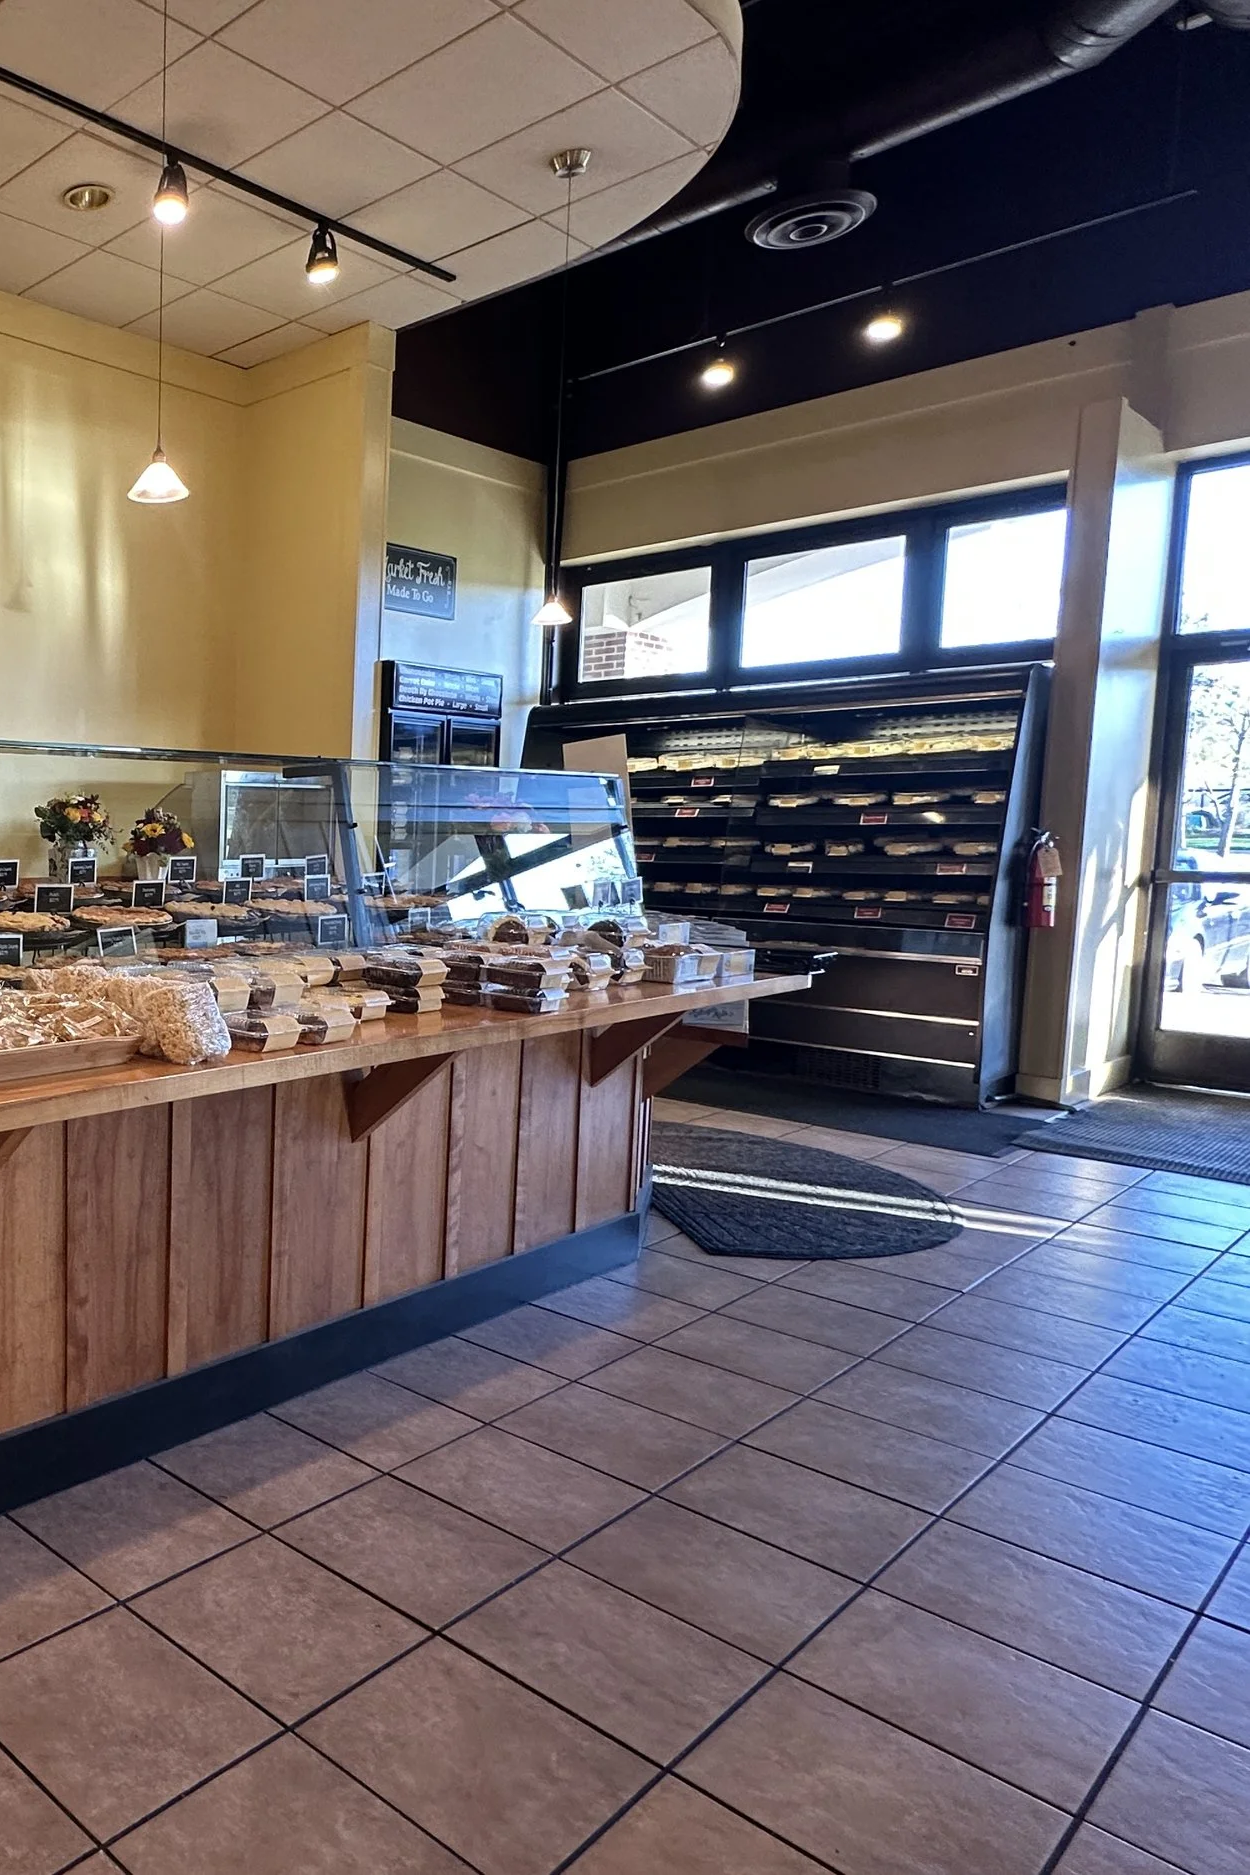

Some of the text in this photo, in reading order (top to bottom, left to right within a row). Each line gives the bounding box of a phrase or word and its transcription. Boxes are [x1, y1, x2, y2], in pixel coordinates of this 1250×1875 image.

[416, 562, 445, 587] Fresh
[387, 584, 434, 603] Made To Go
[399, 695, 422, 704] Chicken
[423, 697, 434, 706] Pot
[435, 698, 445, 707] Pie
